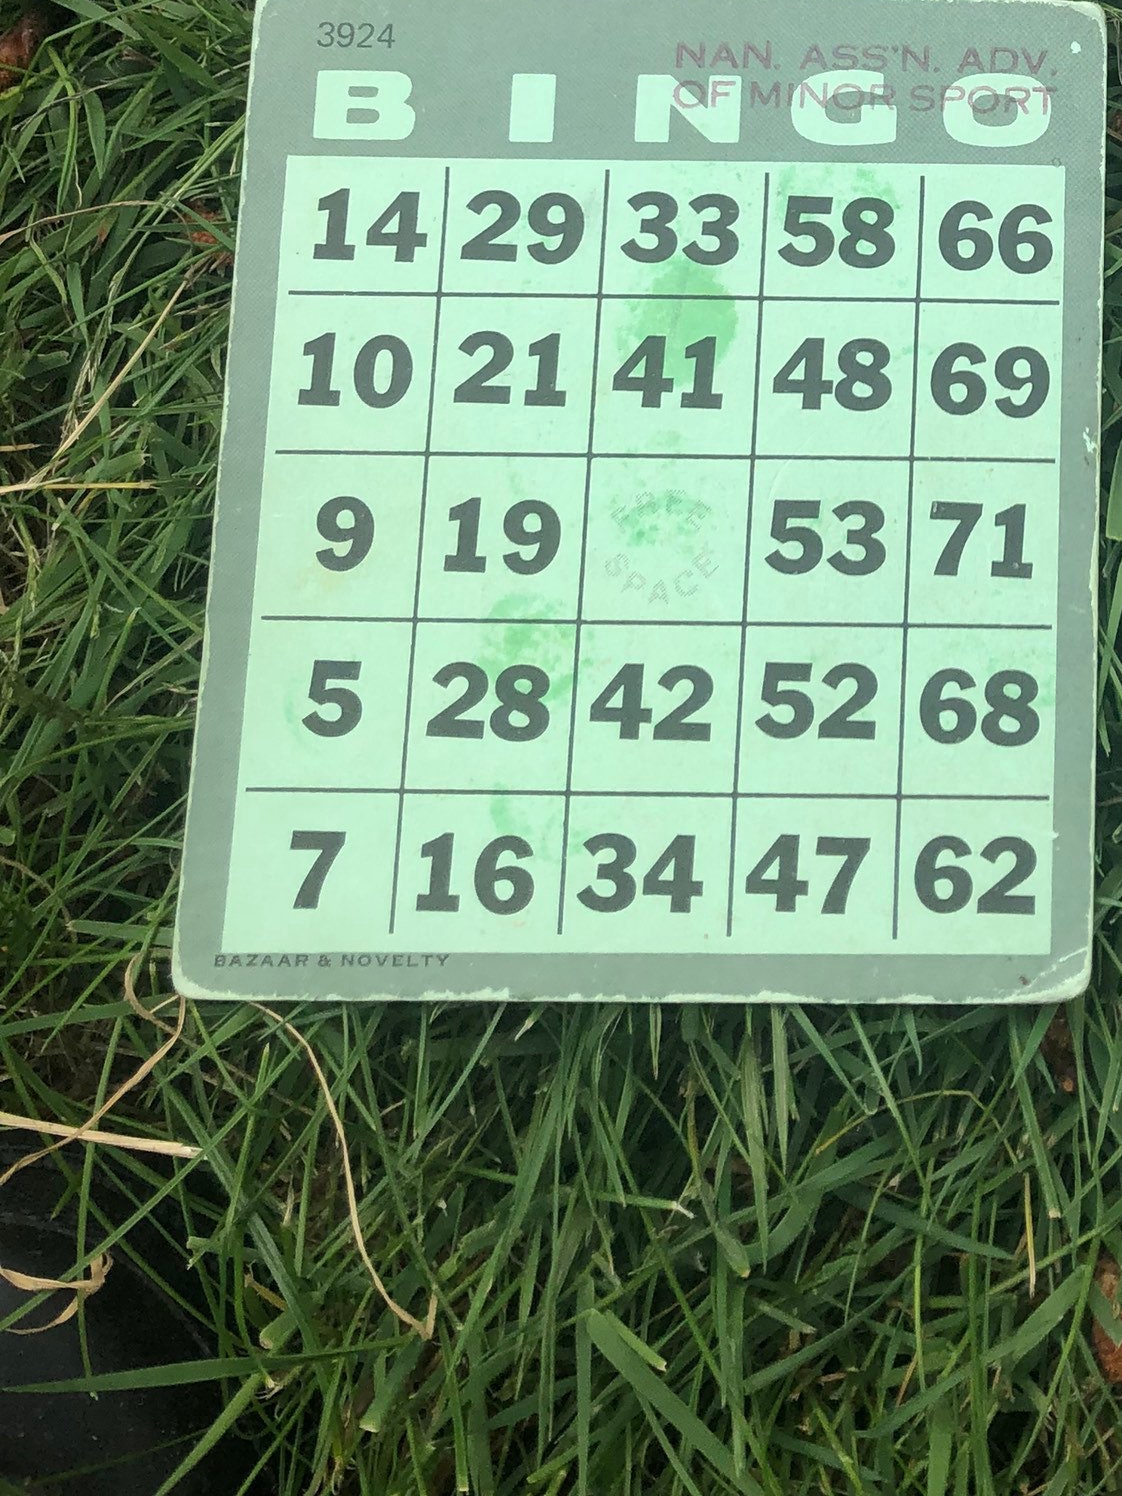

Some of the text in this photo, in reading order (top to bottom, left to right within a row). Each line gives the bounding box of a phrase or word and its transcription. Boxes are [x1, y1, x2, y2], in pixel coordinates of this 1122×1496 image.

[316, 21, 397, 49] 3924
[674, 40, 1059, 77] NAN. ASS'N. ADV.
[672, 78, 1058, 116] OF MINOR SPORT
[313, 188, 1053, 274] 14 29 33 58 66
[298, 331, 1050, 418] 10 21 41 48 69
[316, 496, 1033, 579] 9 19 53 71
[302, 660, 1039, 747] 5 28 42 52 68
[290, 831, 1036, 915] 7 16 34 47 62
[213, 953, 451, 968] BAZAAR & NOVELTY
